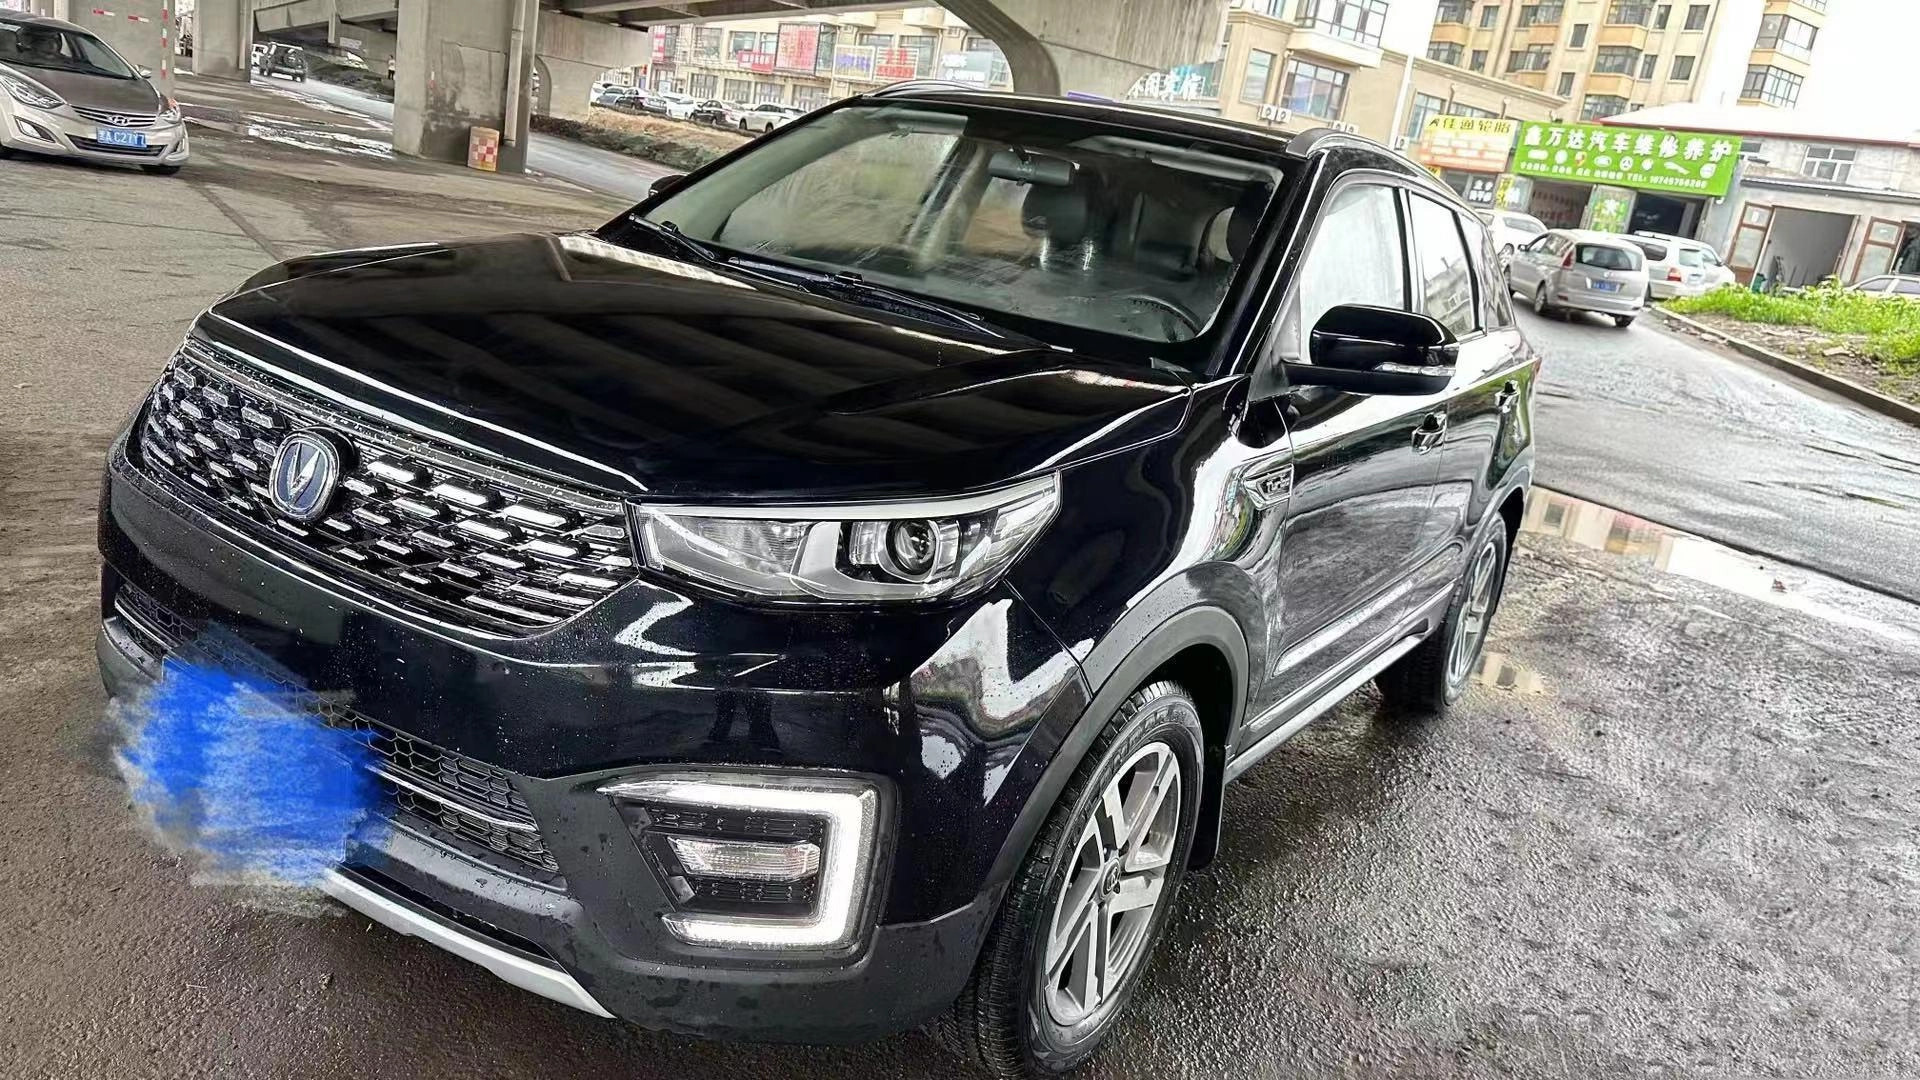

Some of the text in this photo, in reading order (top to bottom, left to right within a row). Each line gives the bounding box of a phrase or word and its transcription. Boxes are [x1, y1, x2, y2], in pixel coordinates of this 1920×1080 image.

[1524, 124, 1733, 163] 鑫万达汽车维修养护
